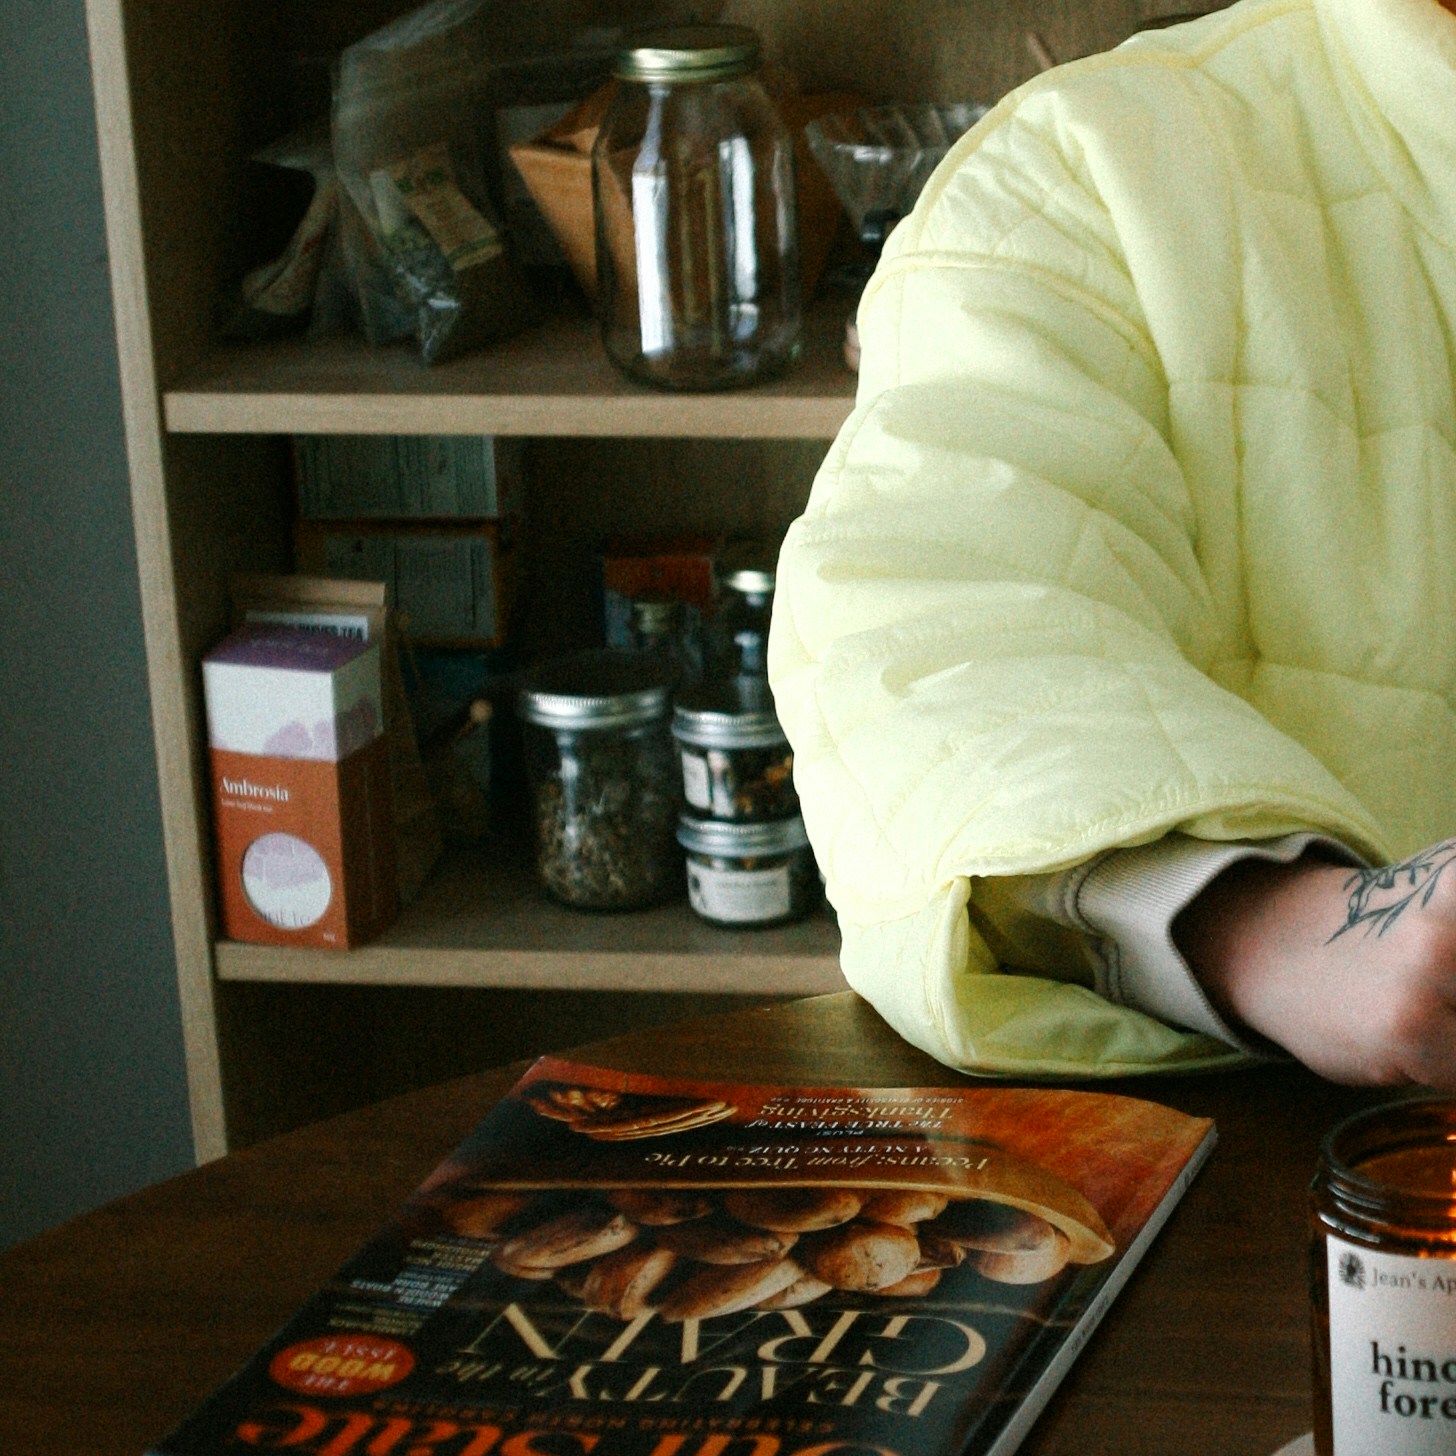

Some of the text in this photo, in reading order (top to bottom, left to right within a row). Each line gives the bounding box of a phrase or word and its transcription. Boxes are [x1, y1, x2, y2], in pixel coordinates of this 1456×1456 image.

[219, 776, 290, 802] Ambrosia
[760, 1103, 954, 1120] Thanksgiving
[744, 1120, 943, 1130] The TRUE FEAST of
[815, 1129, 864, 1137] PLUS!
[748, 1145, 801, 1155] QUIZ
[804, 1145, 830, 1154] NC
[842, 1145, 906, 1155] NUTTY
[914, 1145, 929, 1154] A
[644, 1152, 691, 1169] Pie
[697, 1155, 729, 1167] to
[735, 1155, 800, 1171] Tree
[806, 1154, 873, 1171] from
[1371, 1267, 1428, 1290] Jean's
[456, 1302, 987, 1375] GRAIN
[324, 1340, 397, 1362] ISSUE
[289, 1351, 397, 1382] WOOD
[303, 1373, 350, 1392] THE
[434, 1360, 942, 1418] BEAUTY in the
[371, 1399, 837, 1434] CELEBRATING NORTH CAROLINA
